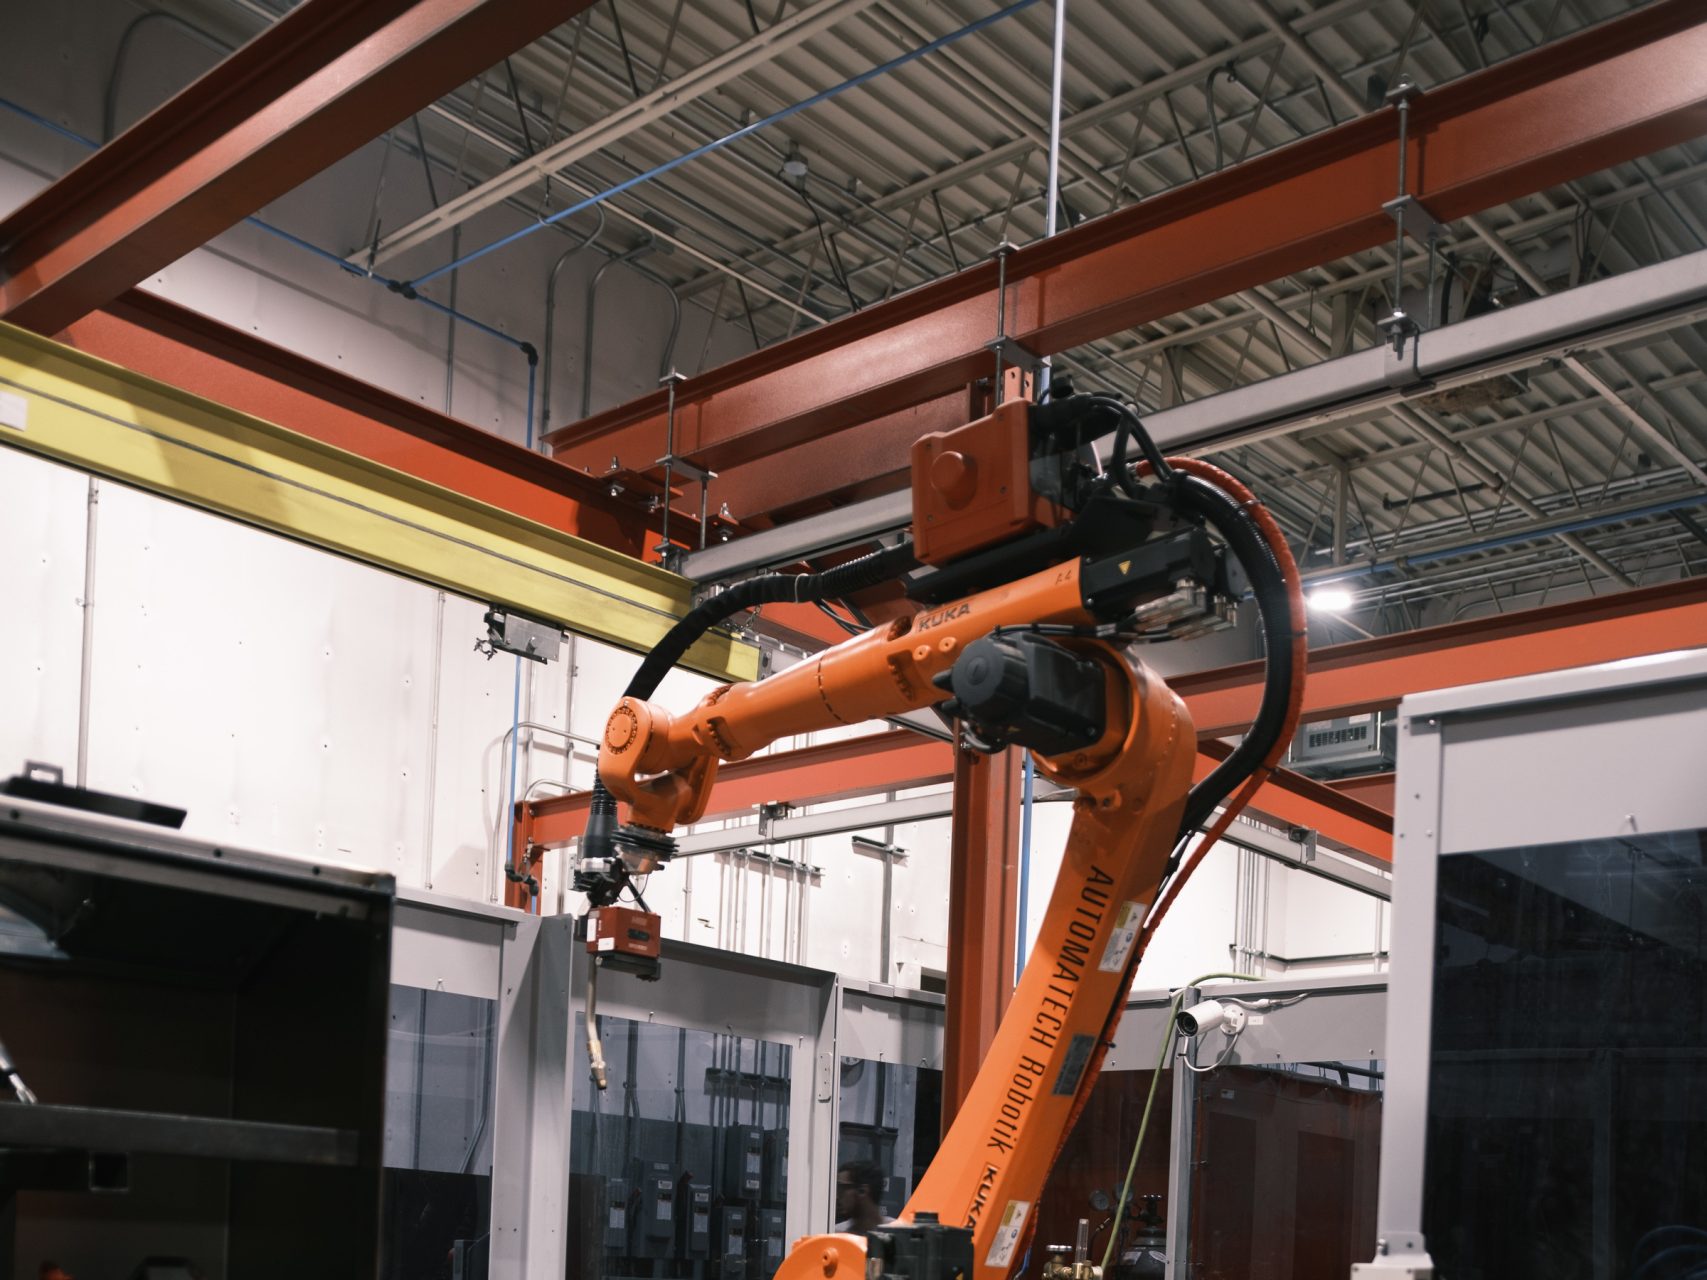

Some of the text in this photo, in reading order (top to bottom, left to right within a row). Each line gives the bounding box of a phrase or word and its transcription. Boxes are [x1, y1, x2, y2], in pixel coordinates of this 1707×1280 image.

[918, 602, 971, 632] KUKA
[1029, 865, 1115, 1049] AUTOMATECH
[986, 1055, 1046, 1155] Robotik
[963, 1166, 998, 1230] KUKA
